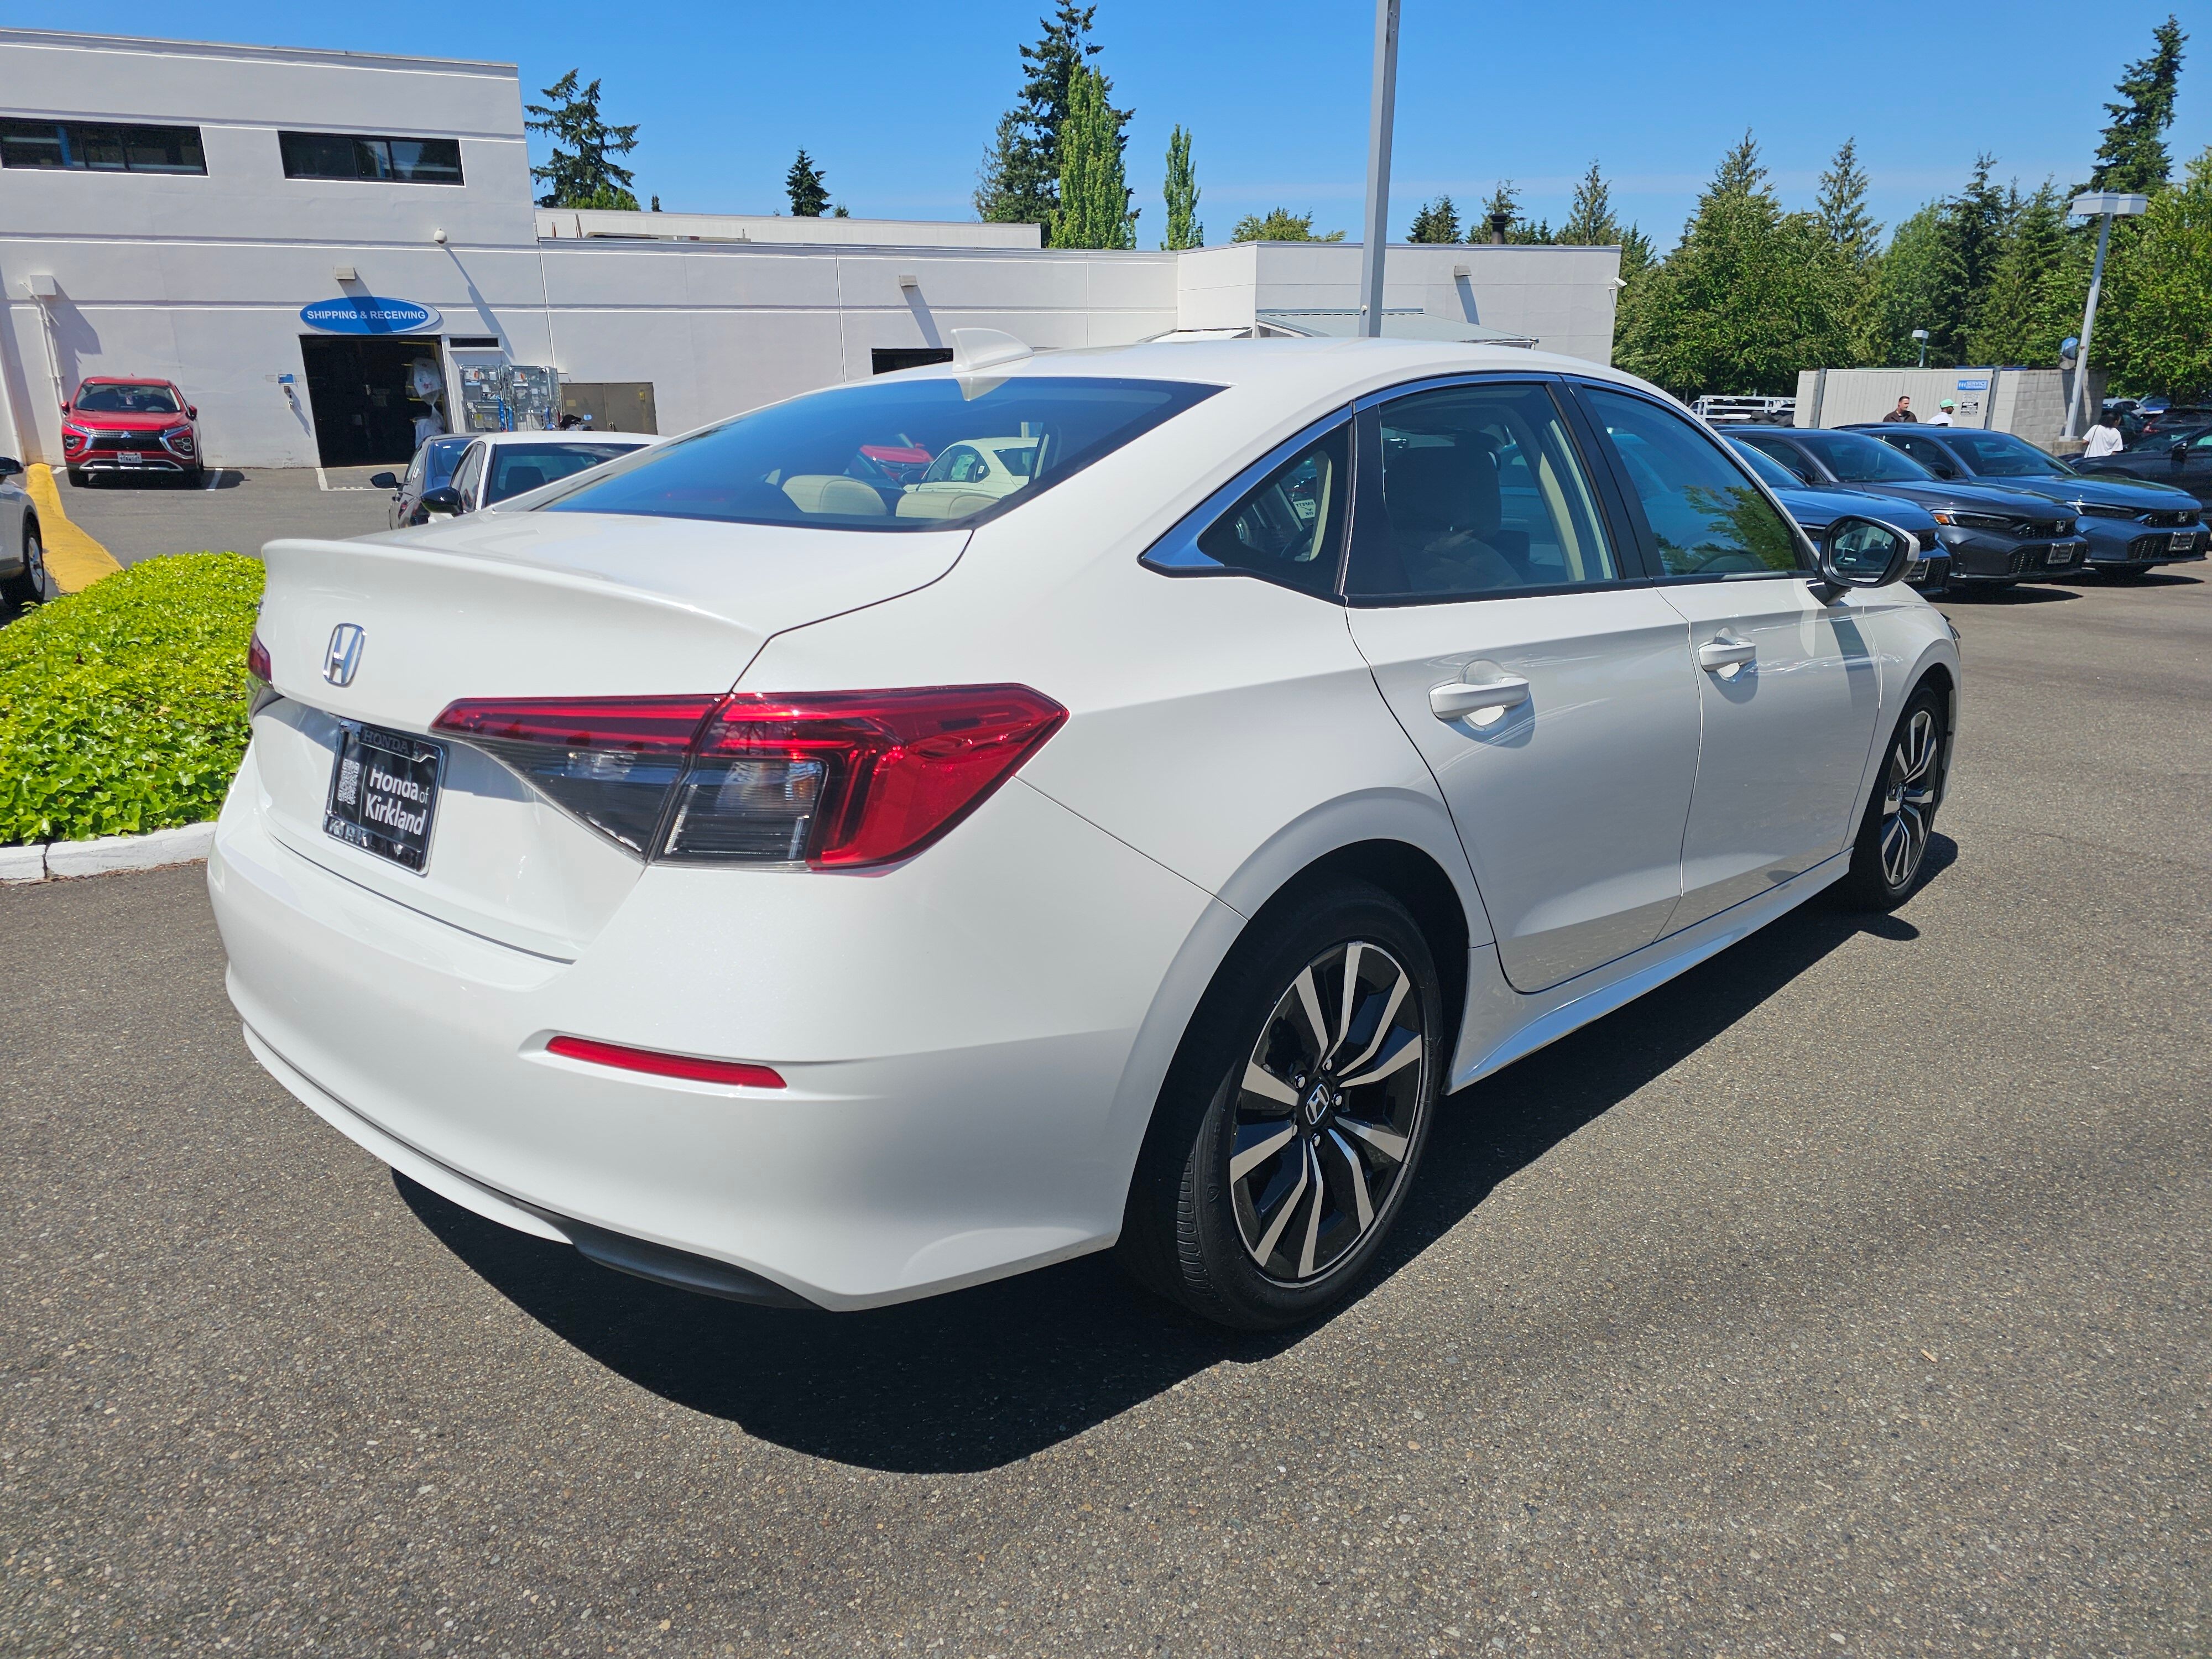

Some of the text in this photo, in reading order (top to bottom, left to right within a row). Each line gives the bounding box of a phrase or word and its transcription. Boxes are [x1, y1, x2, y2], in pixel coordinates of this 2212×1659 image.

[307, 310, 425, 319] SHIPPING & RECEIVING
[362, 728, 410, 755] HONDA
[369, 764, 430, 805] Honda of
[365, 793, 427, 836] Kirkland
